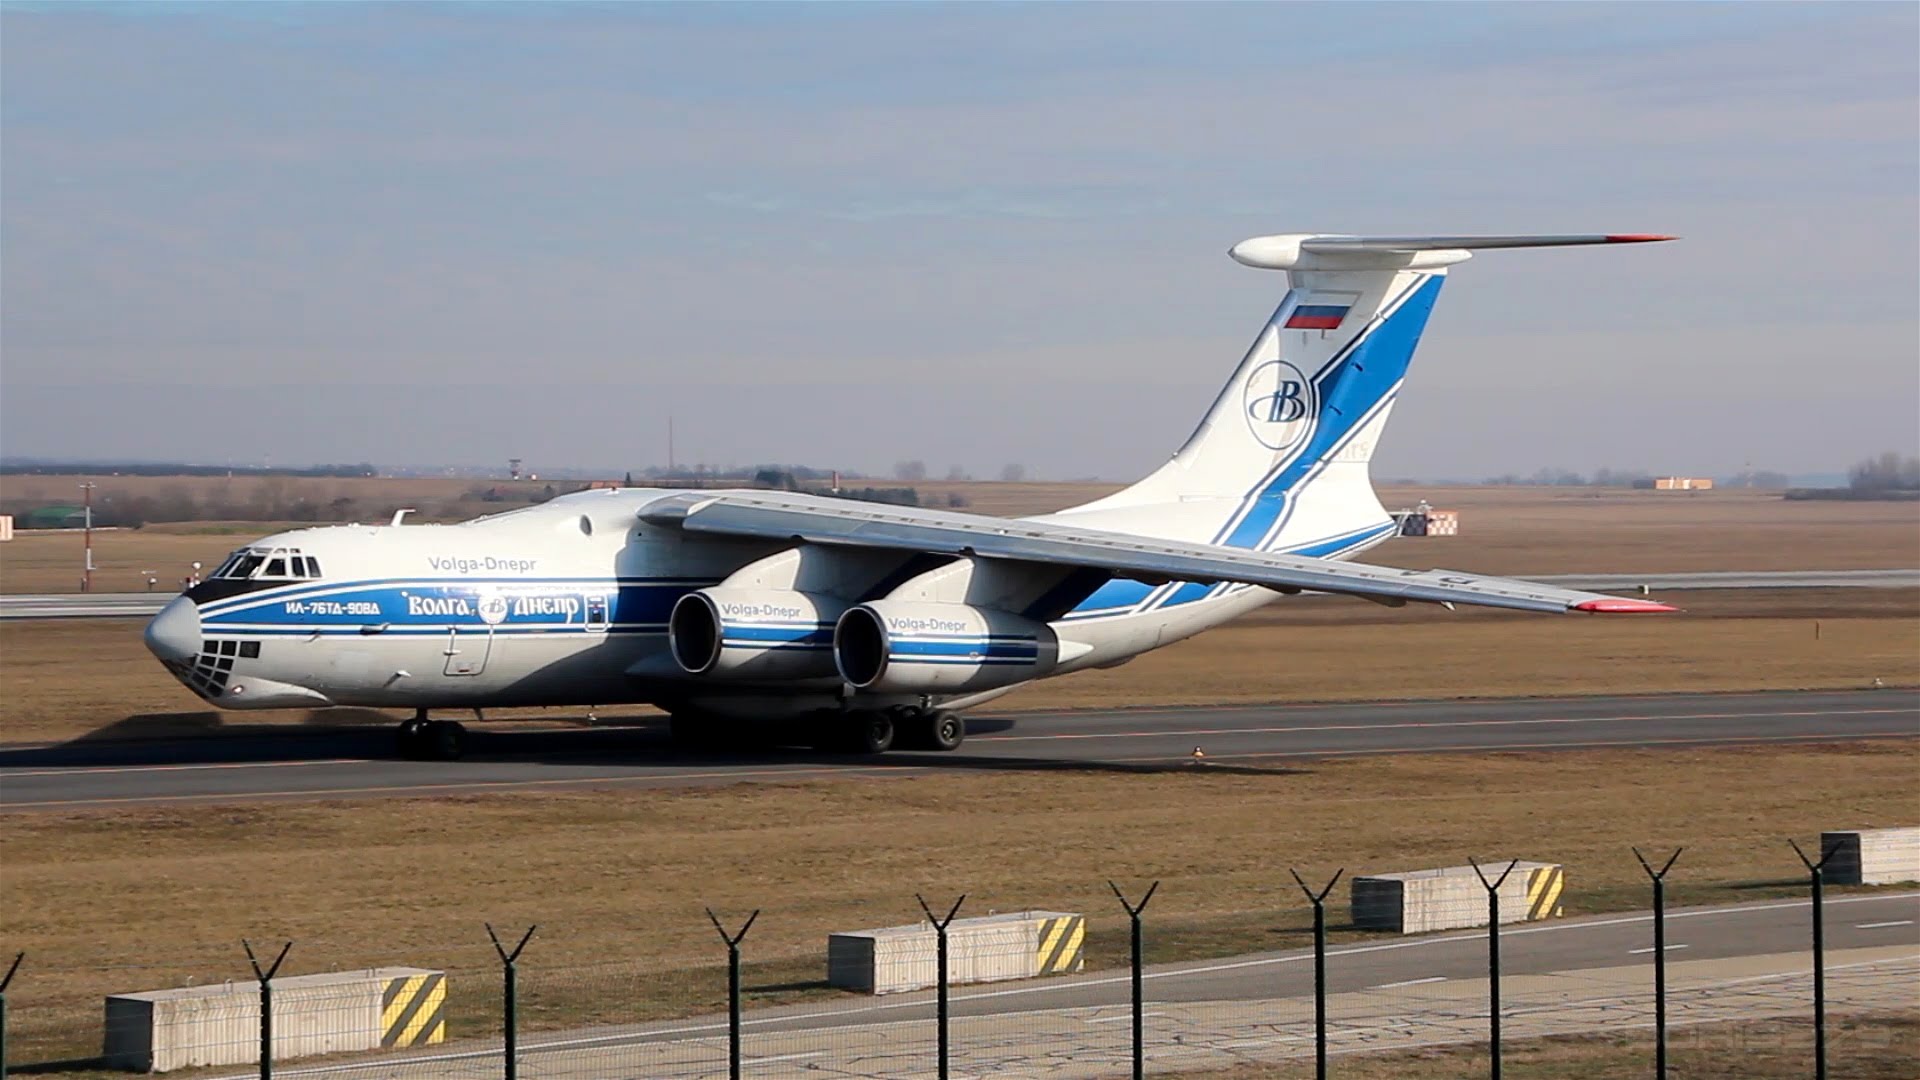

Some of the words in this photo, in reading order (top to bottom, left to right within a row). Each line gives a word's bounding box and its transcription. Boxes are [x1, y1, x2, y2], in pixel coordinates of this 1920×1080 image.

[427, 556, 536, 574] Volga-Dnepr
[722, 604, 801, 618] Volga-Dnepr
[889, 617, 967, 632] Volga-Dnepr
